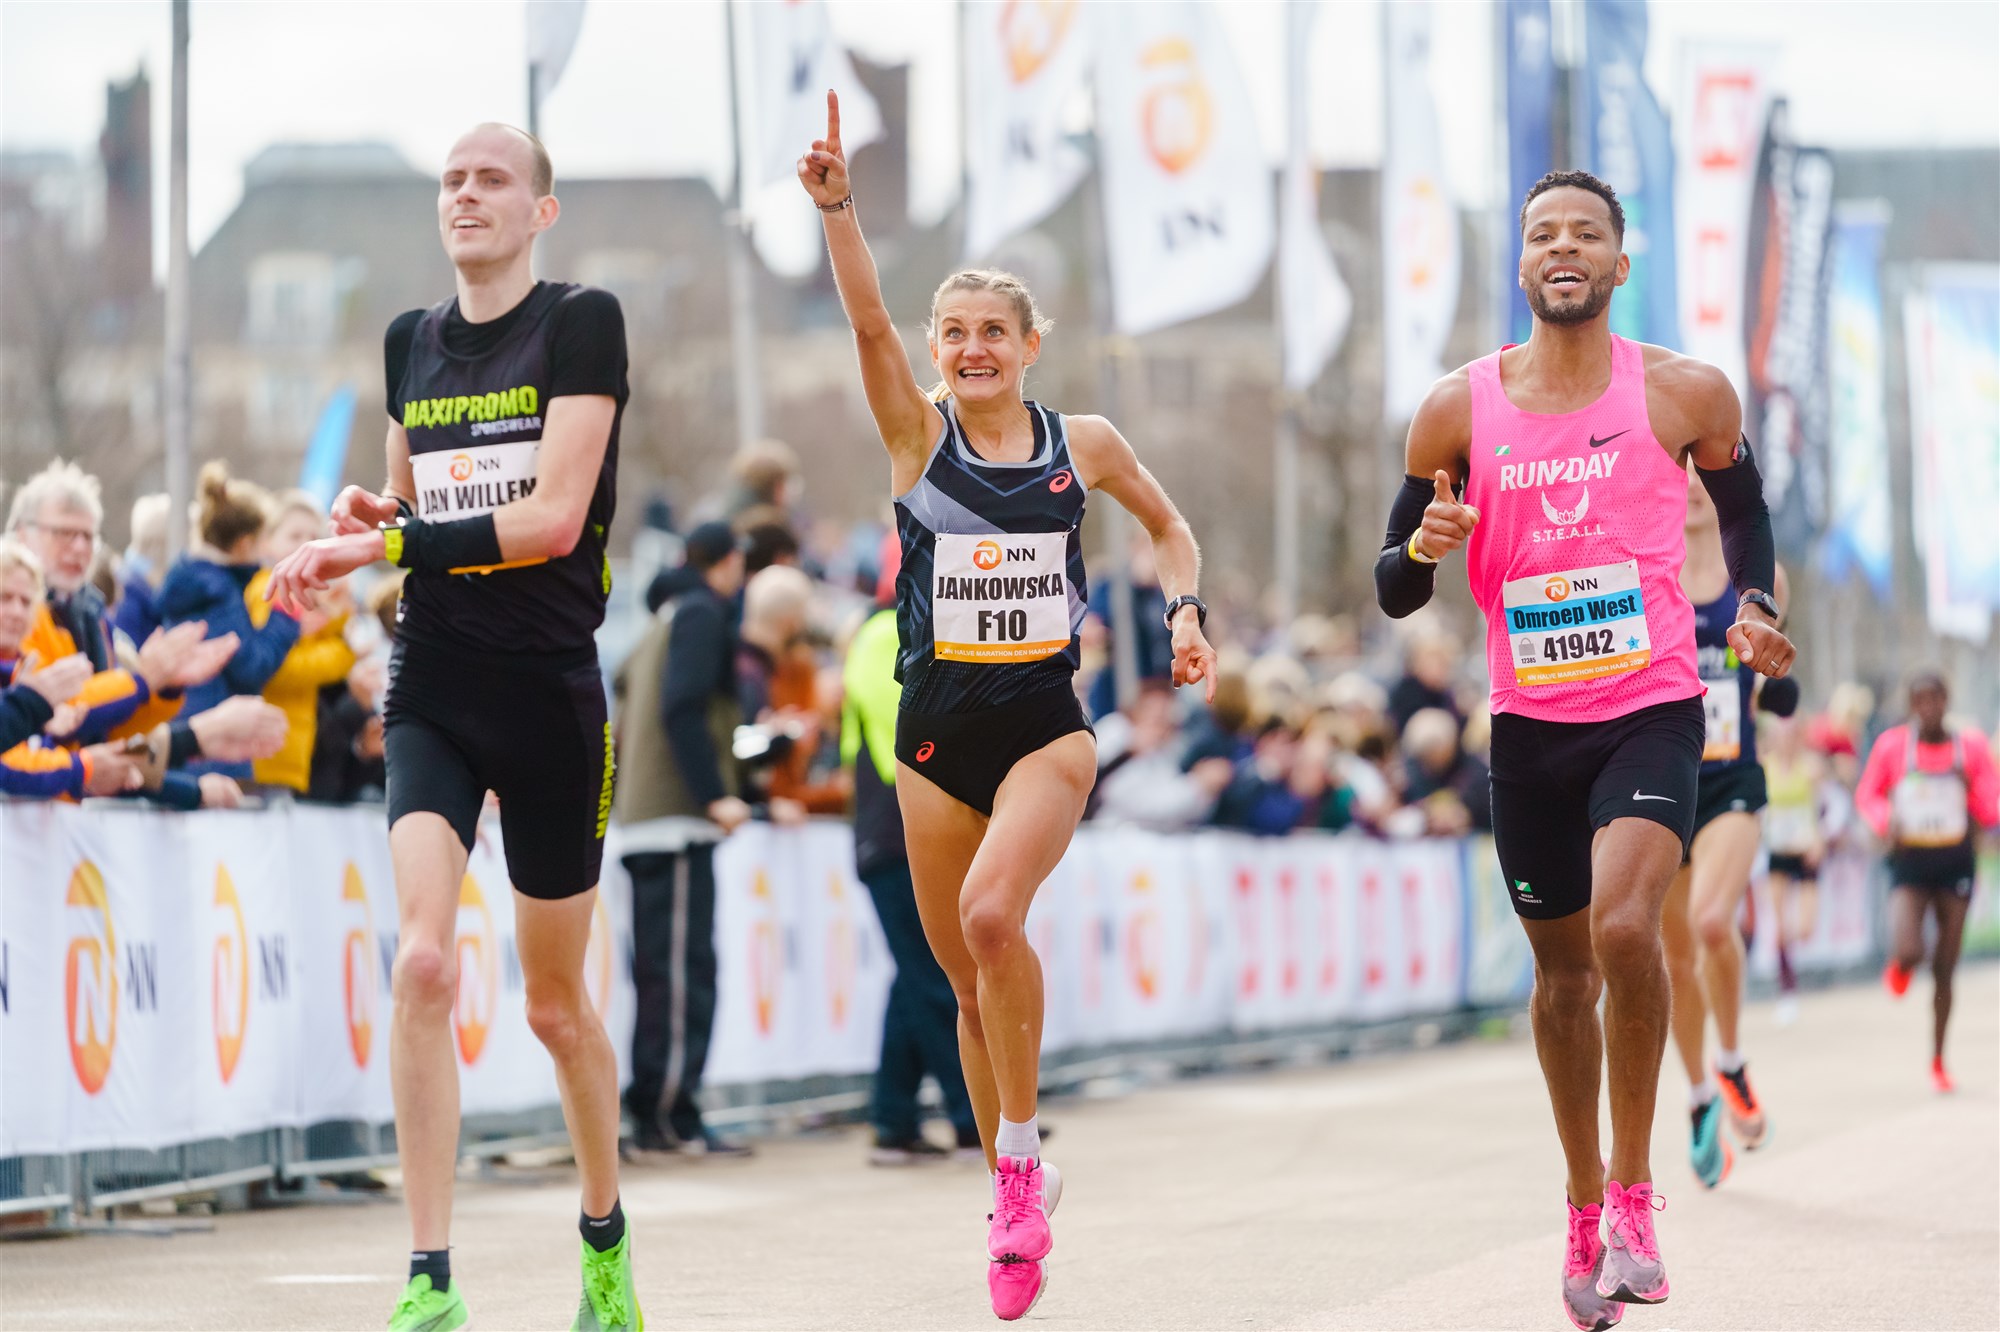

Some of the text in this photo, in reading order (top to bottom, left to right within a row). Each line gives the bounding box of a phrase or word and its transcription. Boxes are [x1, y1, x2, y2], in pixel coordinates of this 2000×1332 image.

[403, 385, 538, 430] MAXIPROMO
[470, 416, 542, 437] SPORTSWEAR
[477, 459, 501, 472] NN
[1500, 451, 1620, 491] RUN2DAY
[424, 487, 449, 515] JAN
[1006, 548, 1036, 562] NN
[936, 573, 1065, 601] JANKOWSKA
[1573, 578, 1599, 592] NN
[978, 609, 1028, 642] F10
[1513, 594, 1637, 631] Omroep West
[1543, 628, 1616, 662] 41942
[1557, 668, 1595, 679] MARATHON
[1610, 661, 1629, 670] HAAG
